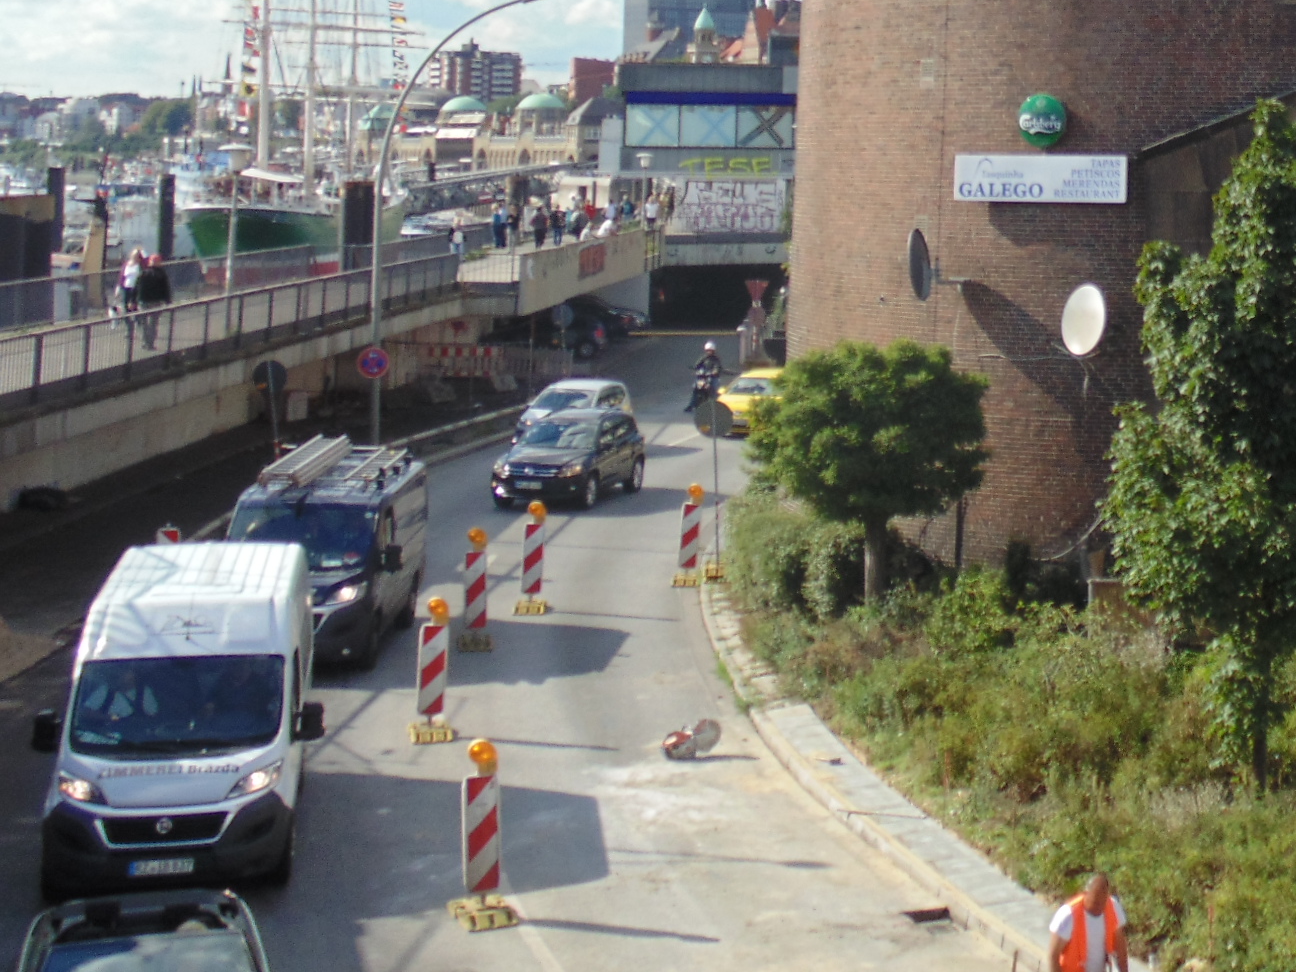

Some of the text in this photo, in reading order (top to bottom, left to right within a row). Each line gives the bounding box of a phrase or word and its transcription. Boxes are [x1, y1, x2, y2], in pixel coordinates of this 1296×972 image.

[1019, 114, 1062, 134] Carlsberg
[1092, 159, 1120, 168] TAPAS
[1071, 169, 1121, 179] PETISCOS
[1062, 179, 1121, 189] MERENDAS
[958, 182, 1044, 198] GALEGO
[1054, 189, 1121, 200] RESTAURANT
